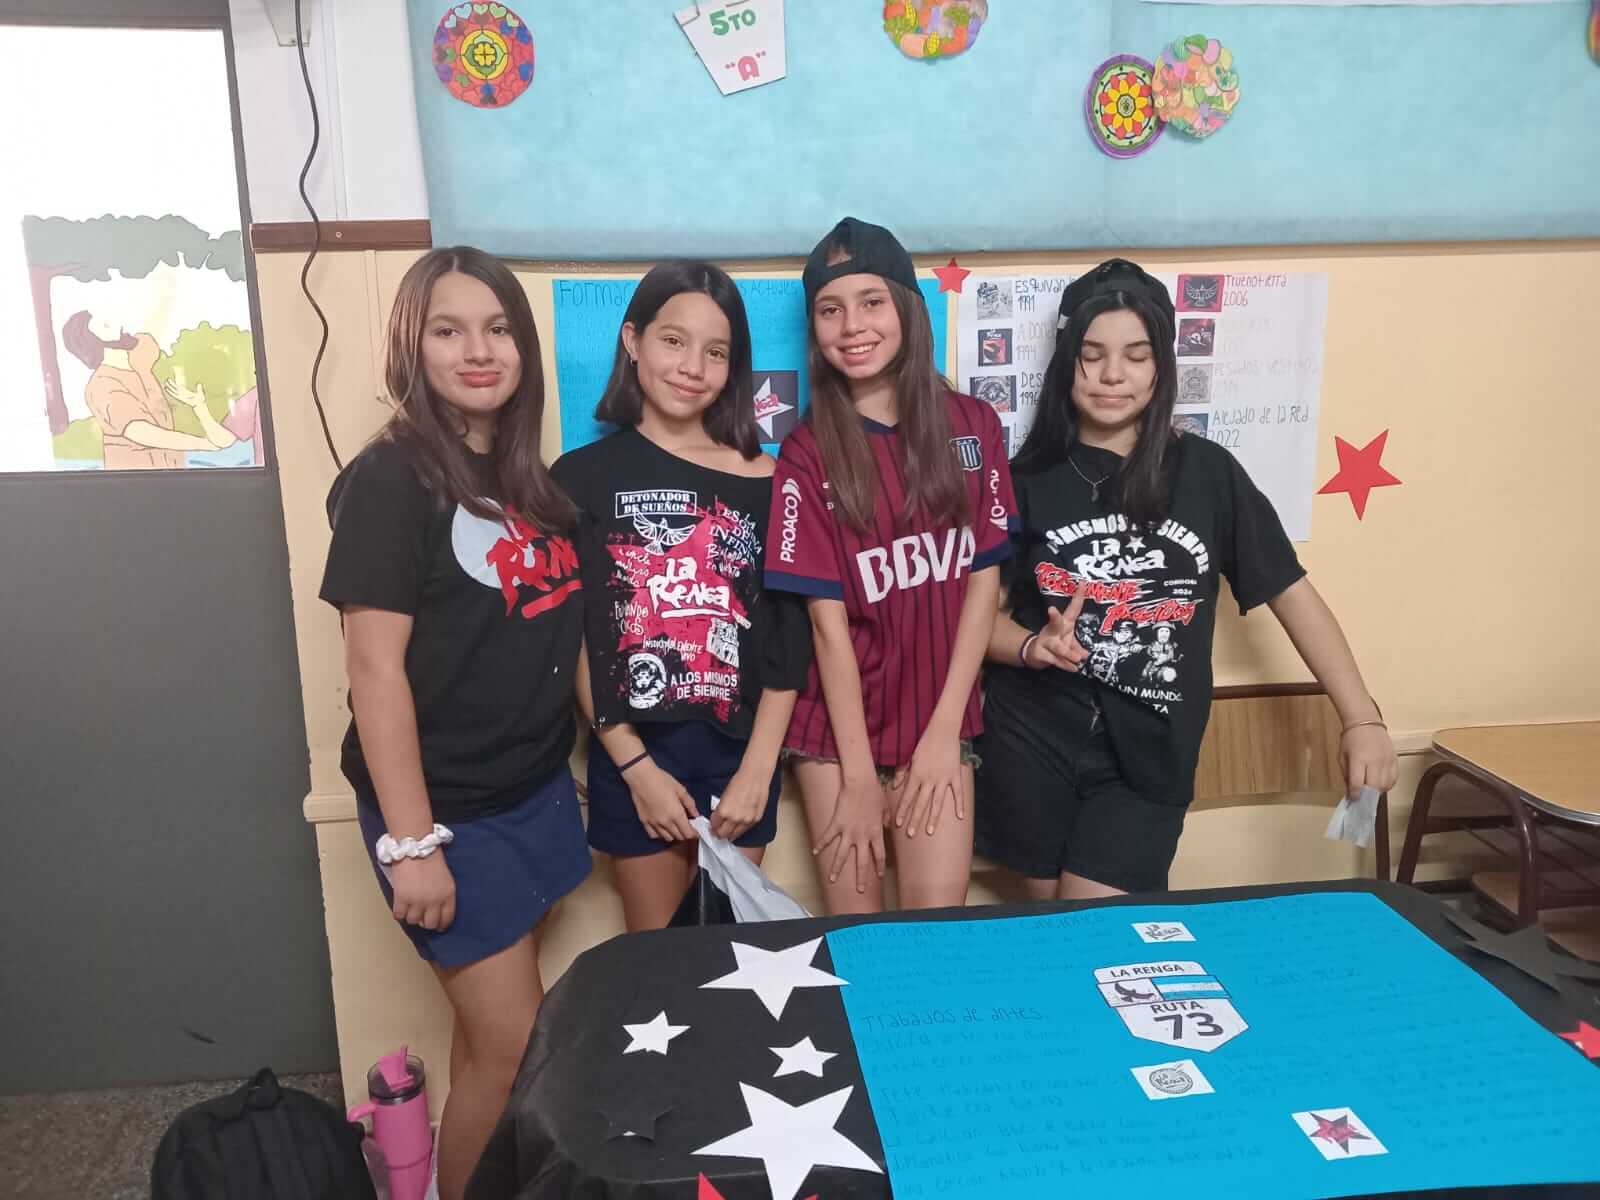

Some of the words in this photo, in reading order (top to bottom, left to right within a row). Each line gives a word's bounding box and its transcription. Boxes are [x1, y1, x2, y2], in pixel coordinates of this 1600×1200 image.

[709, 9, 756, 36] 5TO
[559, 281, 632, 308] Formac
[1021, 371, 1046, 388] Des
[621, 492, 690, 505] DETONADOR
[624, 504, 640, 514] DE
[642, 502, 688, 513] SUEÑOS
[780, 497, 799, 563] PROACO
[1056, 514, 1128, 545] MISMOS
[1156, 519, 1209, 575] SIEMPRE
[856, 527, 976, 604] BBVA
[671, 674, 679, 688] A
[680, 671, 701, 685] LOS
[704, 672, 738, 688] MISMOS
[676, 686, 692, 700] DE
[694, 685, 732, 702] SIEMPRE
[1110, 969, 1131, 978] LA
[1132, 964, 1186, 976] RENGA
[1150, 1000, 1204, 1014] RUTA
[1153, 1012, 1224, 1041] 73
